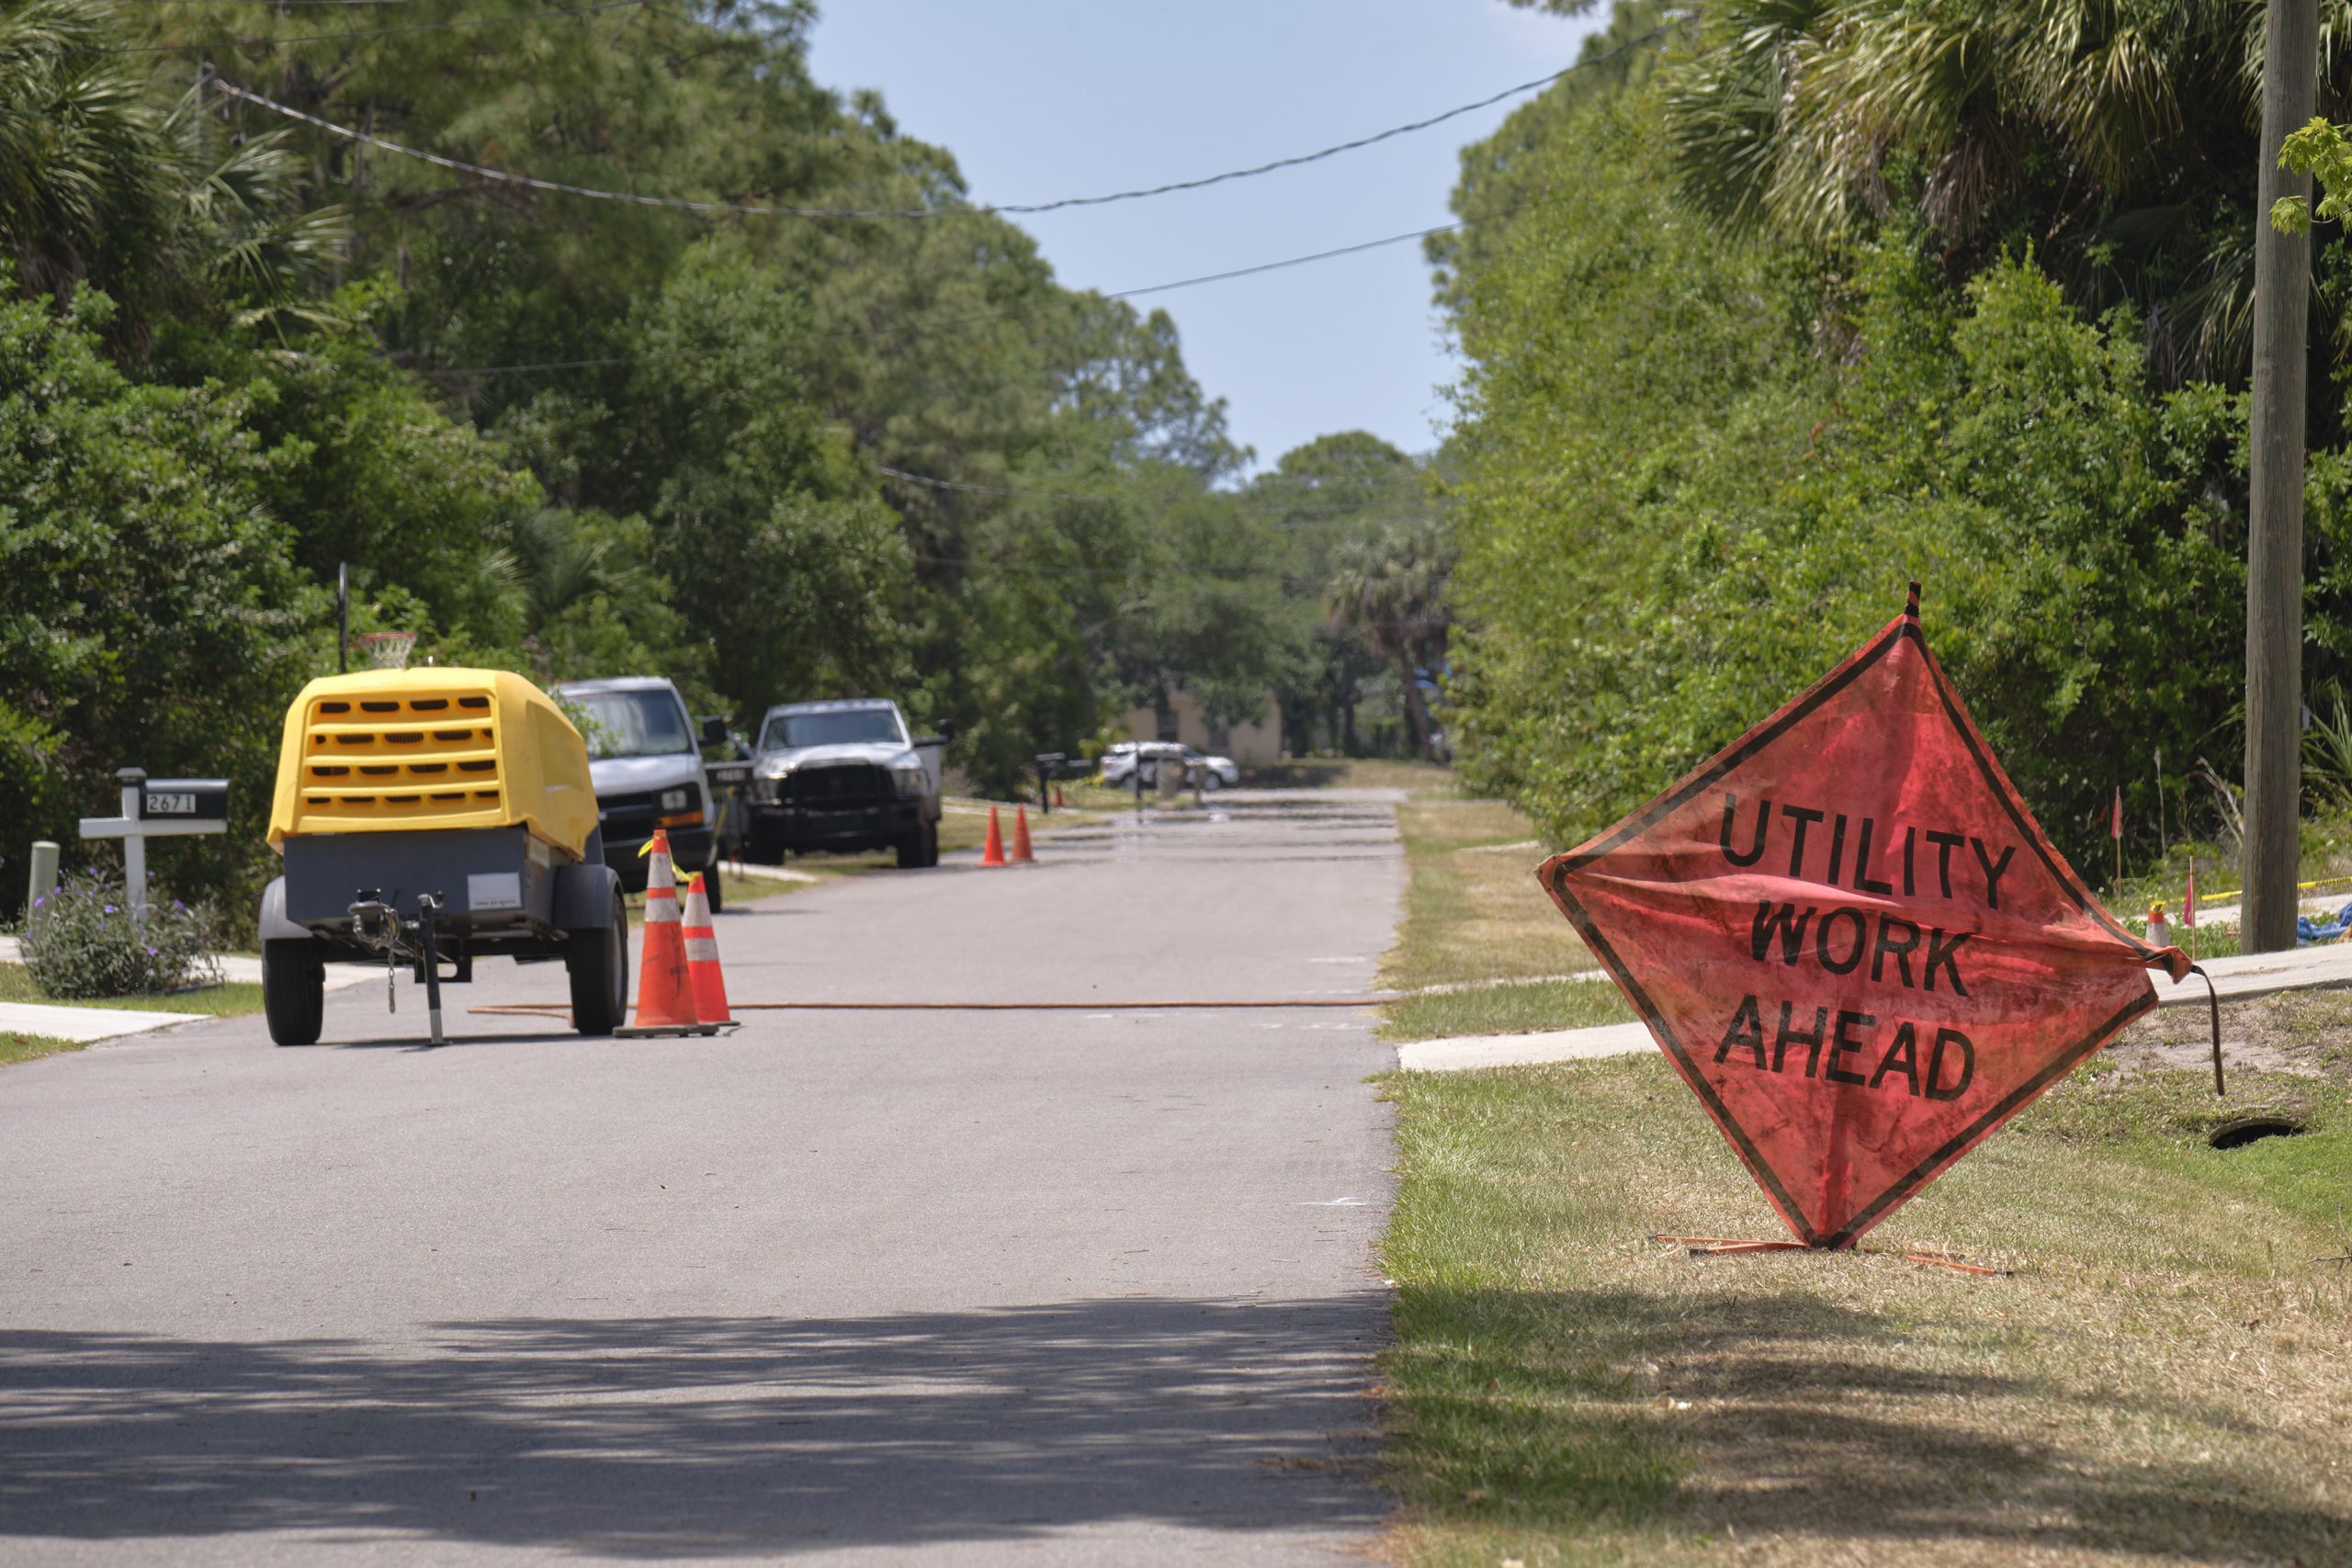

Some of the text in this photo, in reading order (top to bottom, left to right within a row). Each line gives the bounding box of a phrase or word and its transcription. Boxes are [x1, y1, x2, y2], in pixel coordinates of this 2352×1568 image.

[150, 795, 191, 811] 2671
[1719, 793, 2016, 909] UTILITY
[1751, 899, 1975, 998] WORK
[1713, 994, 1974, 1101] AHEAD
